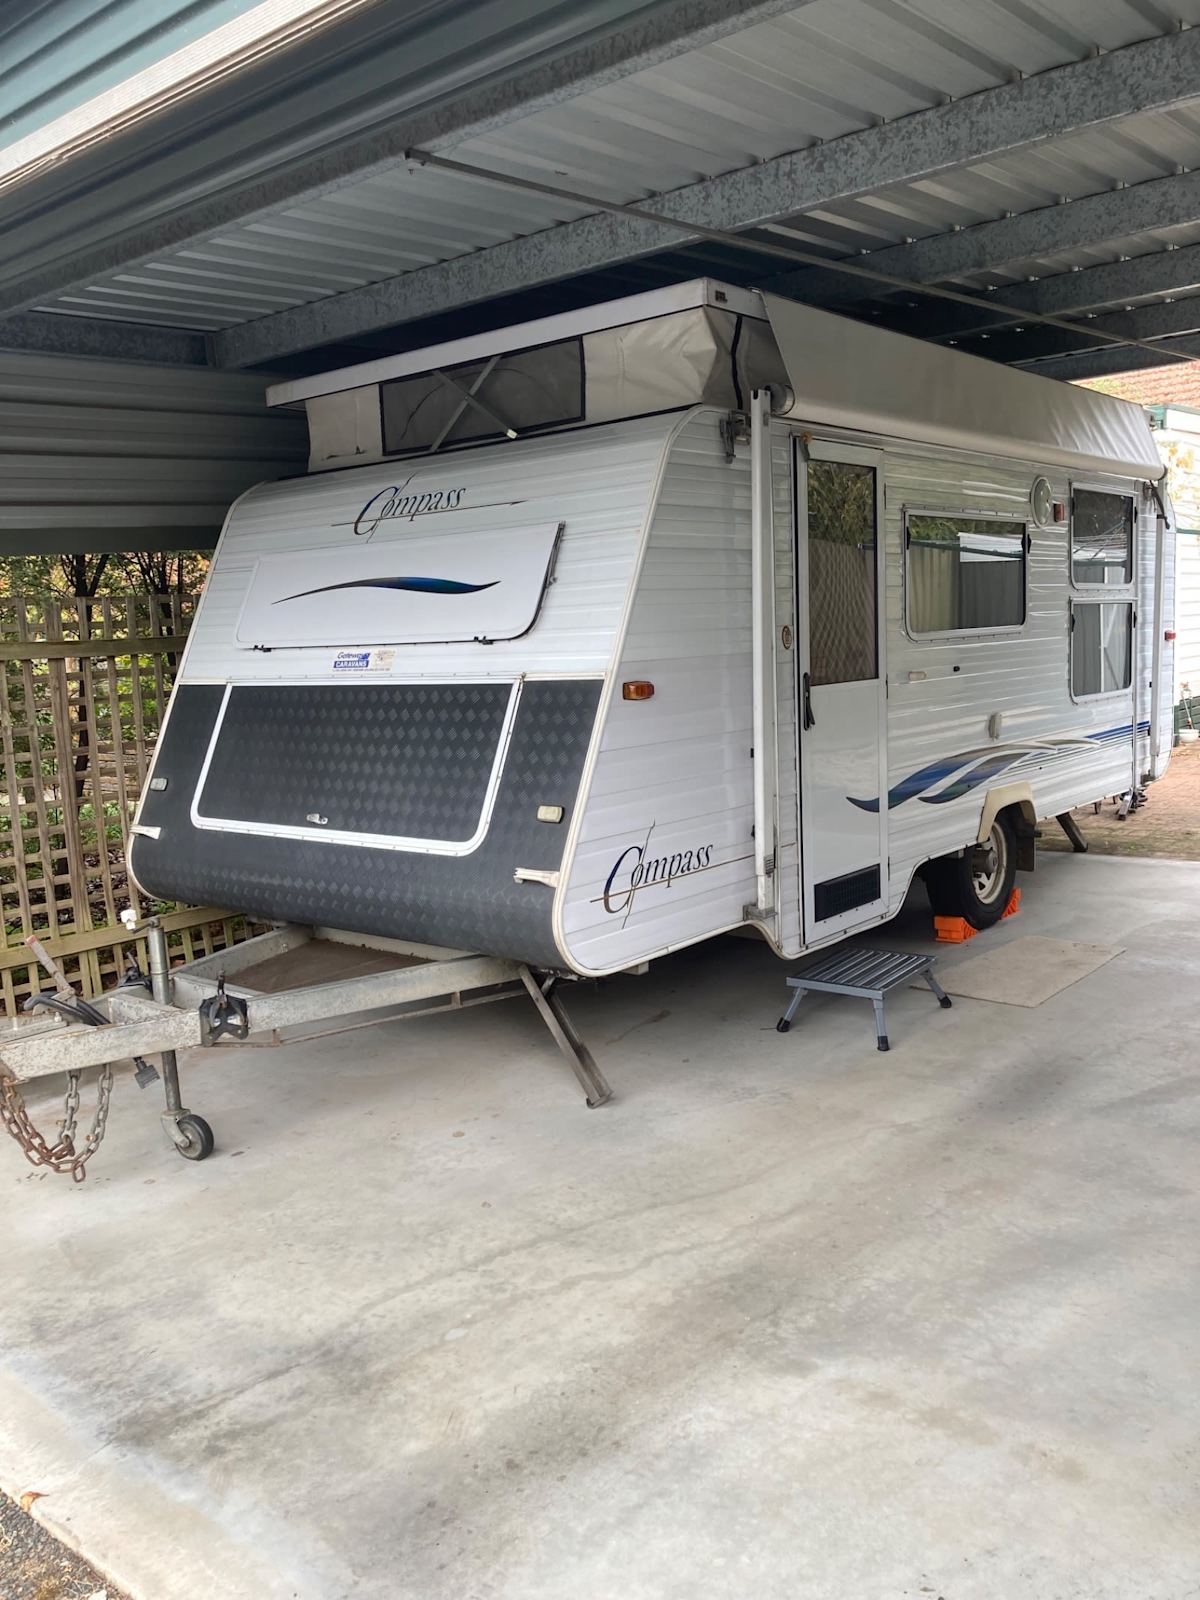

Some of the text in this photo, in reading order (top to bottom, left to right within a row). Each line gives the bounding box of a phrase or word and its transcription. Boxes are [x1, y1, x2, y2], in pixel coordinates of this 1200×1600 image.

[353, 485, 467, 537] Compass
[335, 660, 368, 668] CARAVANS
[603, 844, 714, 914] Compass
